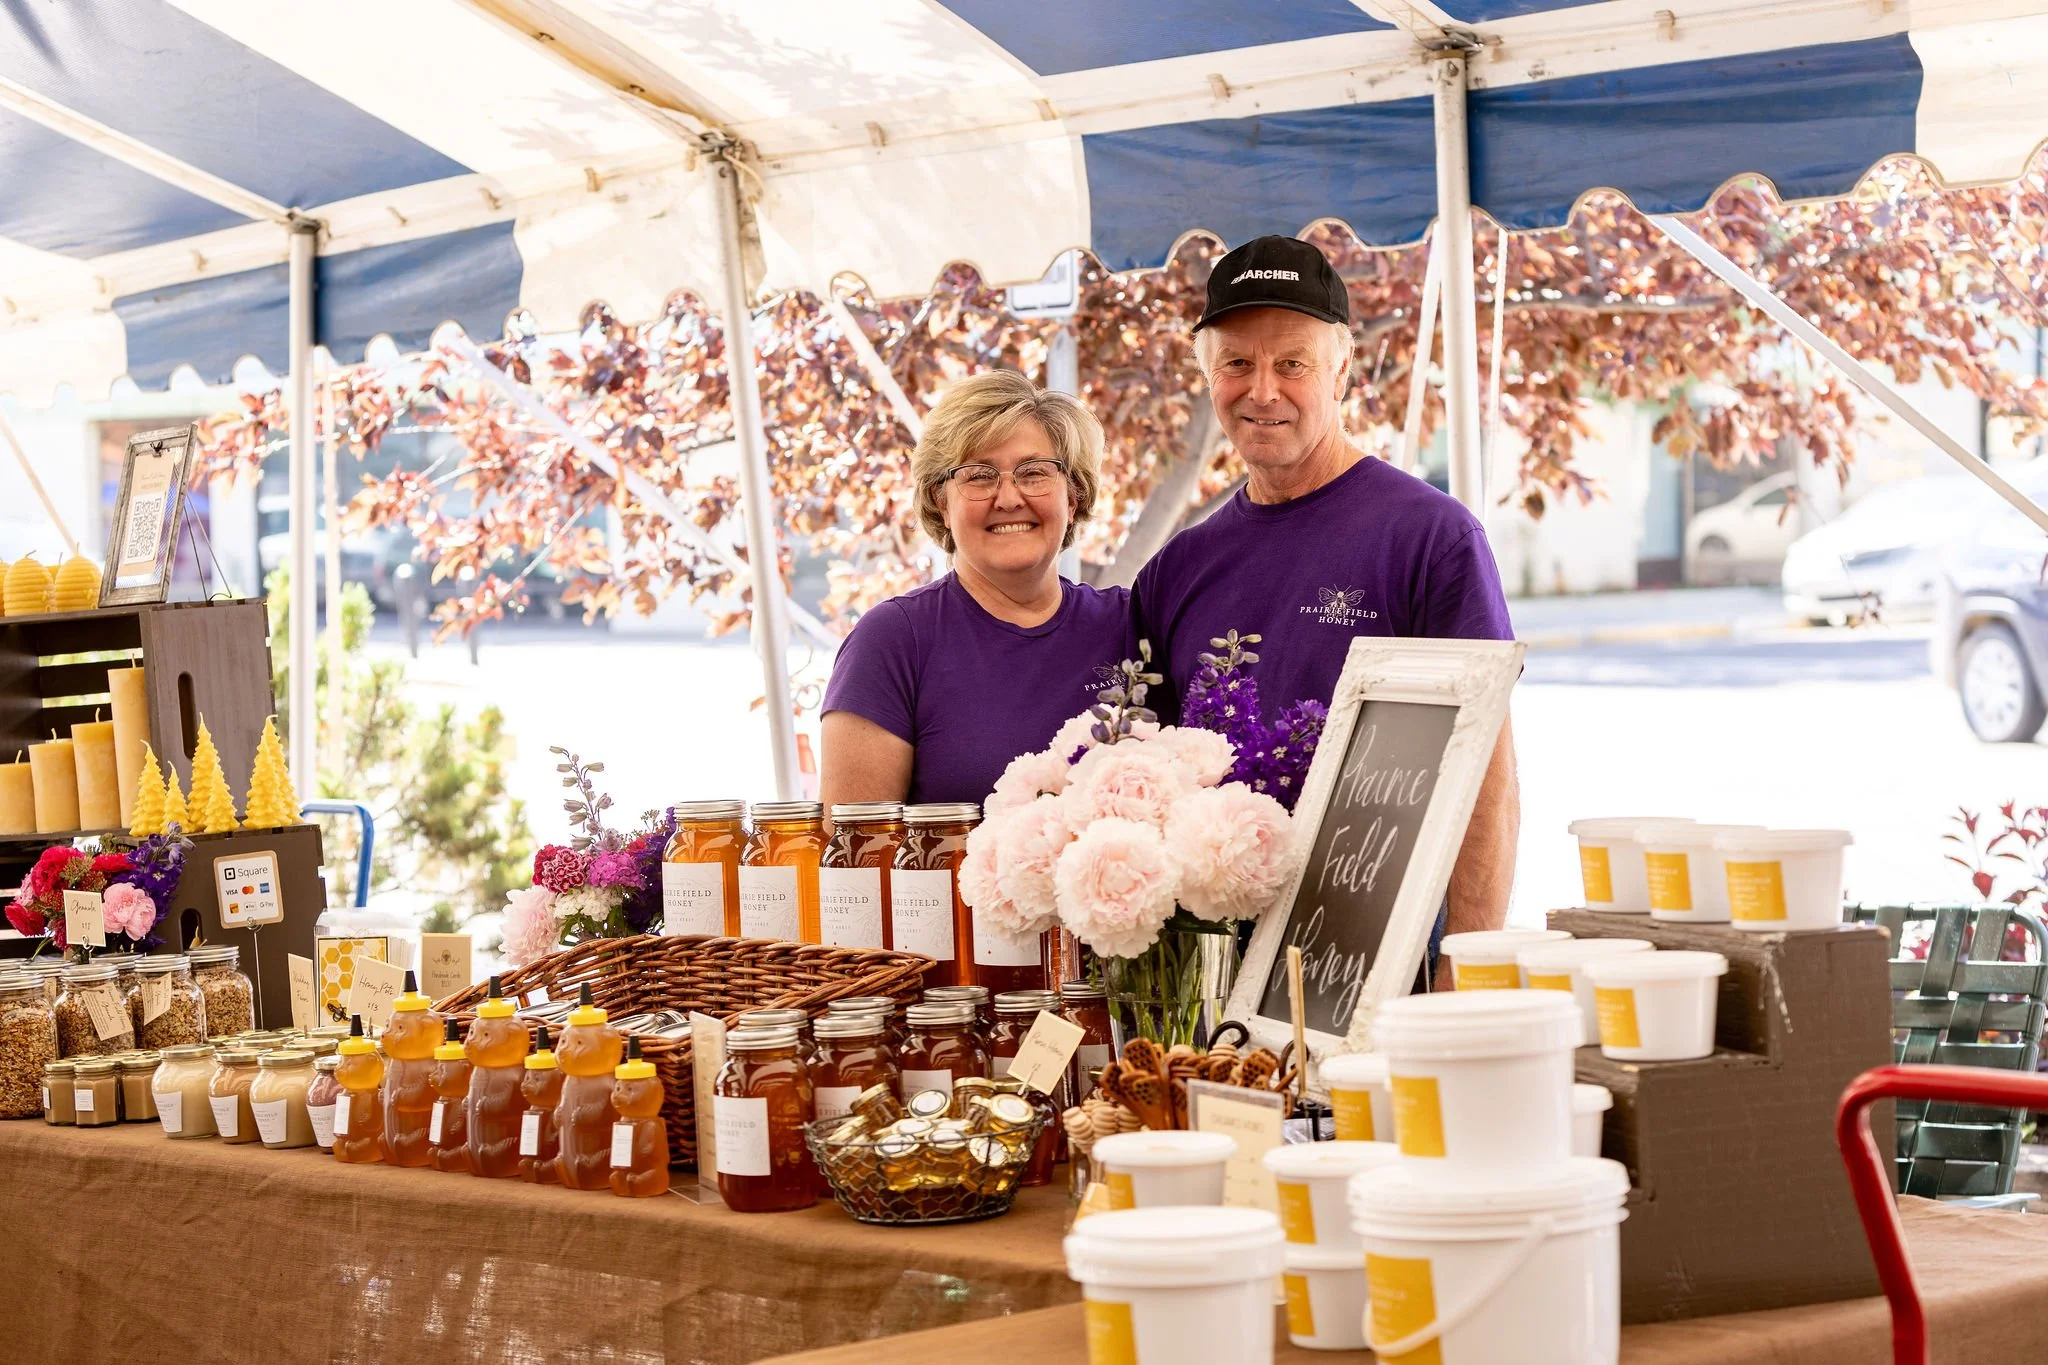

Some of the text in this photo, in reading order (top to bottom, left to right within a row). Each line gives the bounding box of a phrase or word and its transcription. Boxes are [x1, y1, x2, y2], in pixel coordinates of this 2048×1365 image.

[1300, 606, 1378, 619] PRAIRIE FIELD
[1318, 616, 1356, 626] HONEY
[1333, 723, 1429, 809] Prairie
[1318, 816, 1398, 893] Field
[237, 867, 268, 878] Square
[757, 893, 786, 901] FIELD
[839, 896, 869, 904] FIELD
[909, 899, 940, 907] FIELD
[896, 909, 920, 917] HONEY
[1272, 904, 1366, 1028] Honey
[359, 975, 380, 996] Honey
